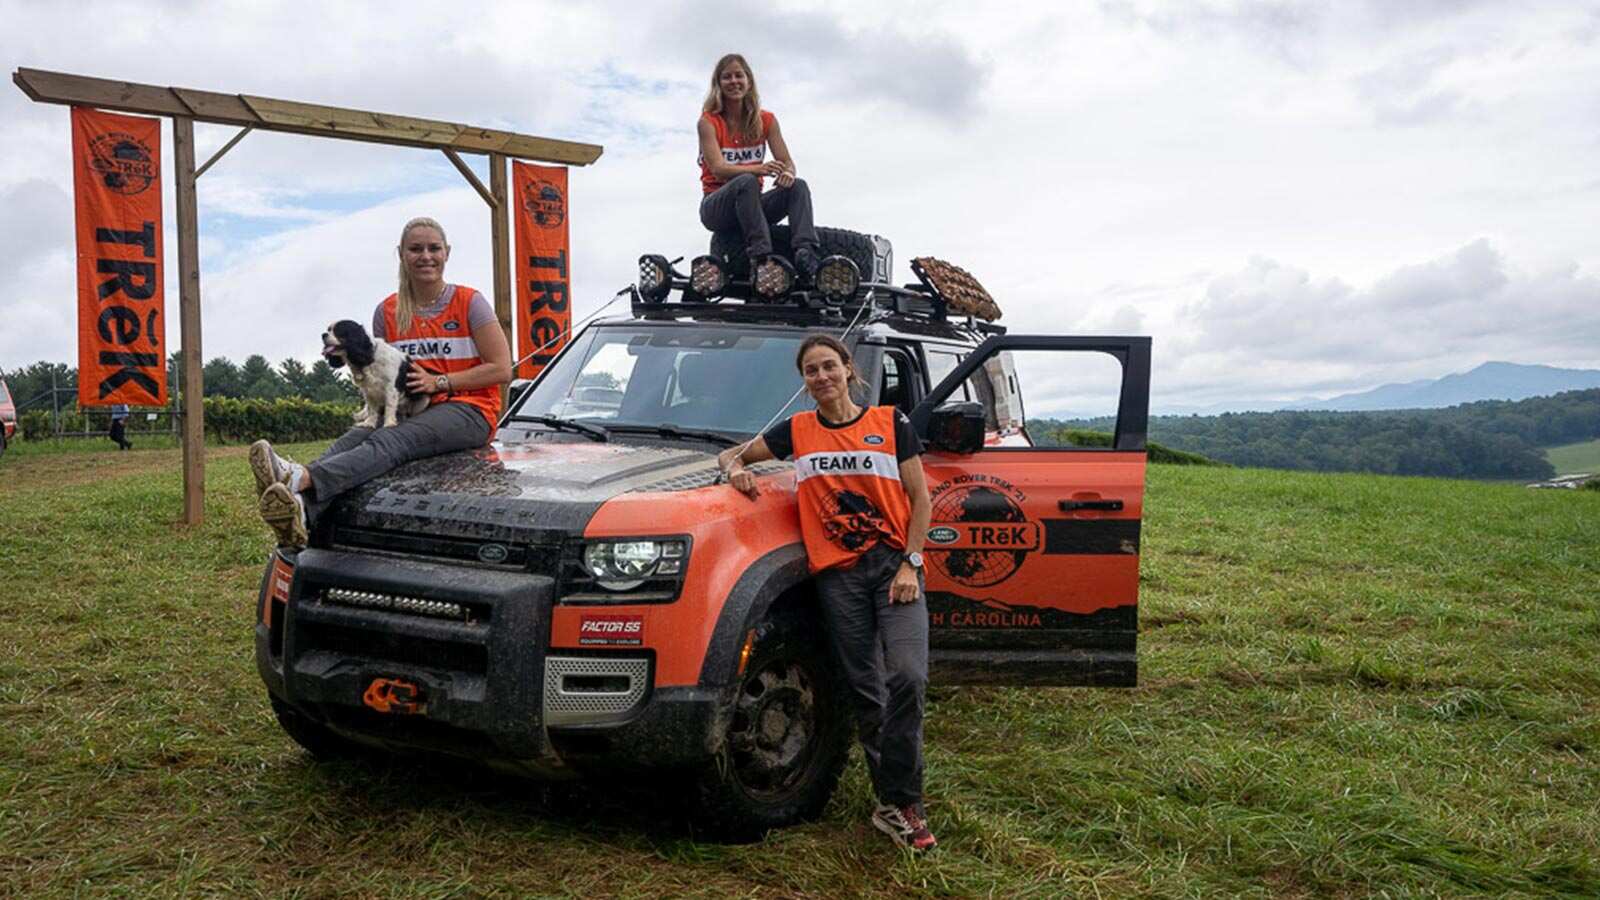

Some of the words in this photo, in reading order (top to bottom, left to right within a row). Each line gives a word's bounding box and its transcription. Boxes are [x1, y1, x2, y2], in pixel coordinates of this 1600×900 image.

[755, 148, 762, 159] 6
[400, 342, 439, 356] TEAM
[442, 342, 452, 355] 6
[809, 456, 857, 471] TEAM
[862, 455, 873, 470] 6
[950, 611, 1041, 626] CAROLINA
[581, 620, 624, 633] FACTOR
